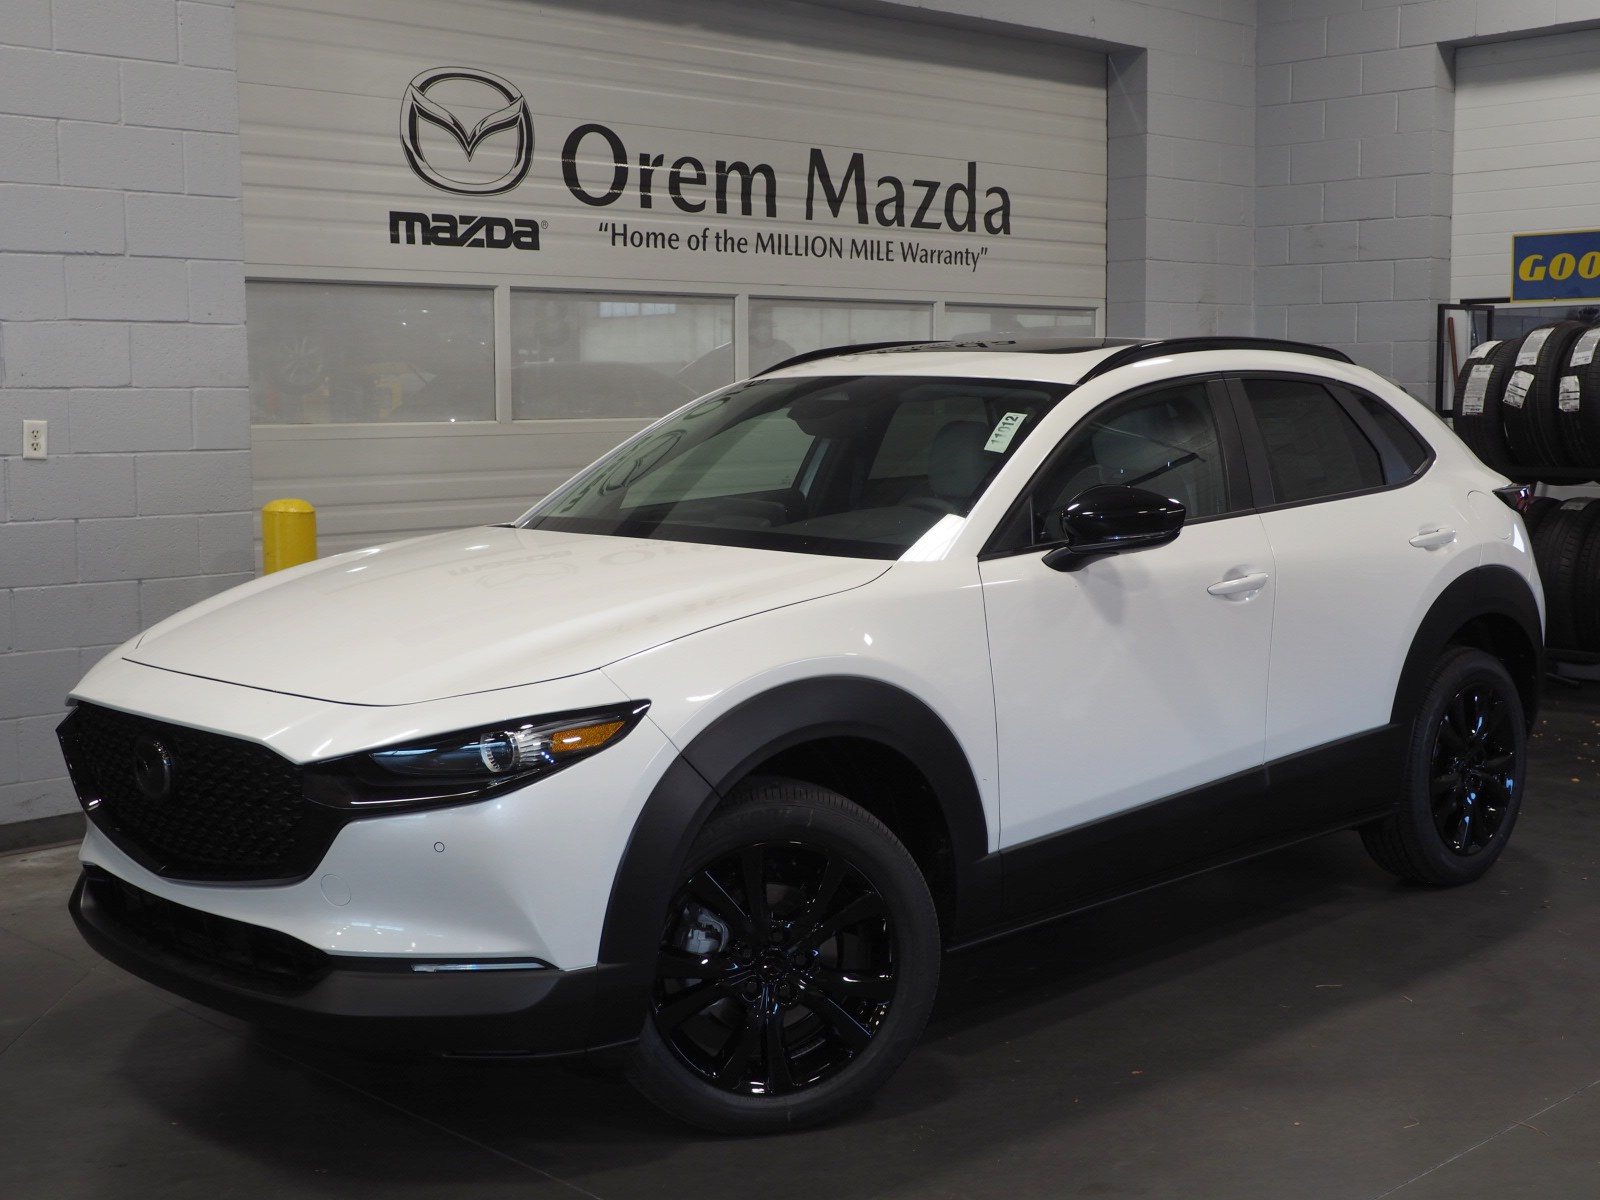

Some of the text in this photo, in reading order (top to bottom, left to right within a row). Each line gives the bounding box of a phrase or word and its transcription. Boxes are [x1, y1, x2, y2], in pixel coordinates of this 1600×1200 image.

[561, 123, 1011, 235] Orem Mazda
[687, 227, 710, 251] of
[715, 229, 748, 253] the
[755, 232, 843, 259] MILLION
[850, 238, 895, 262] MILE
[1519, 251, 1600, 281] GOO
